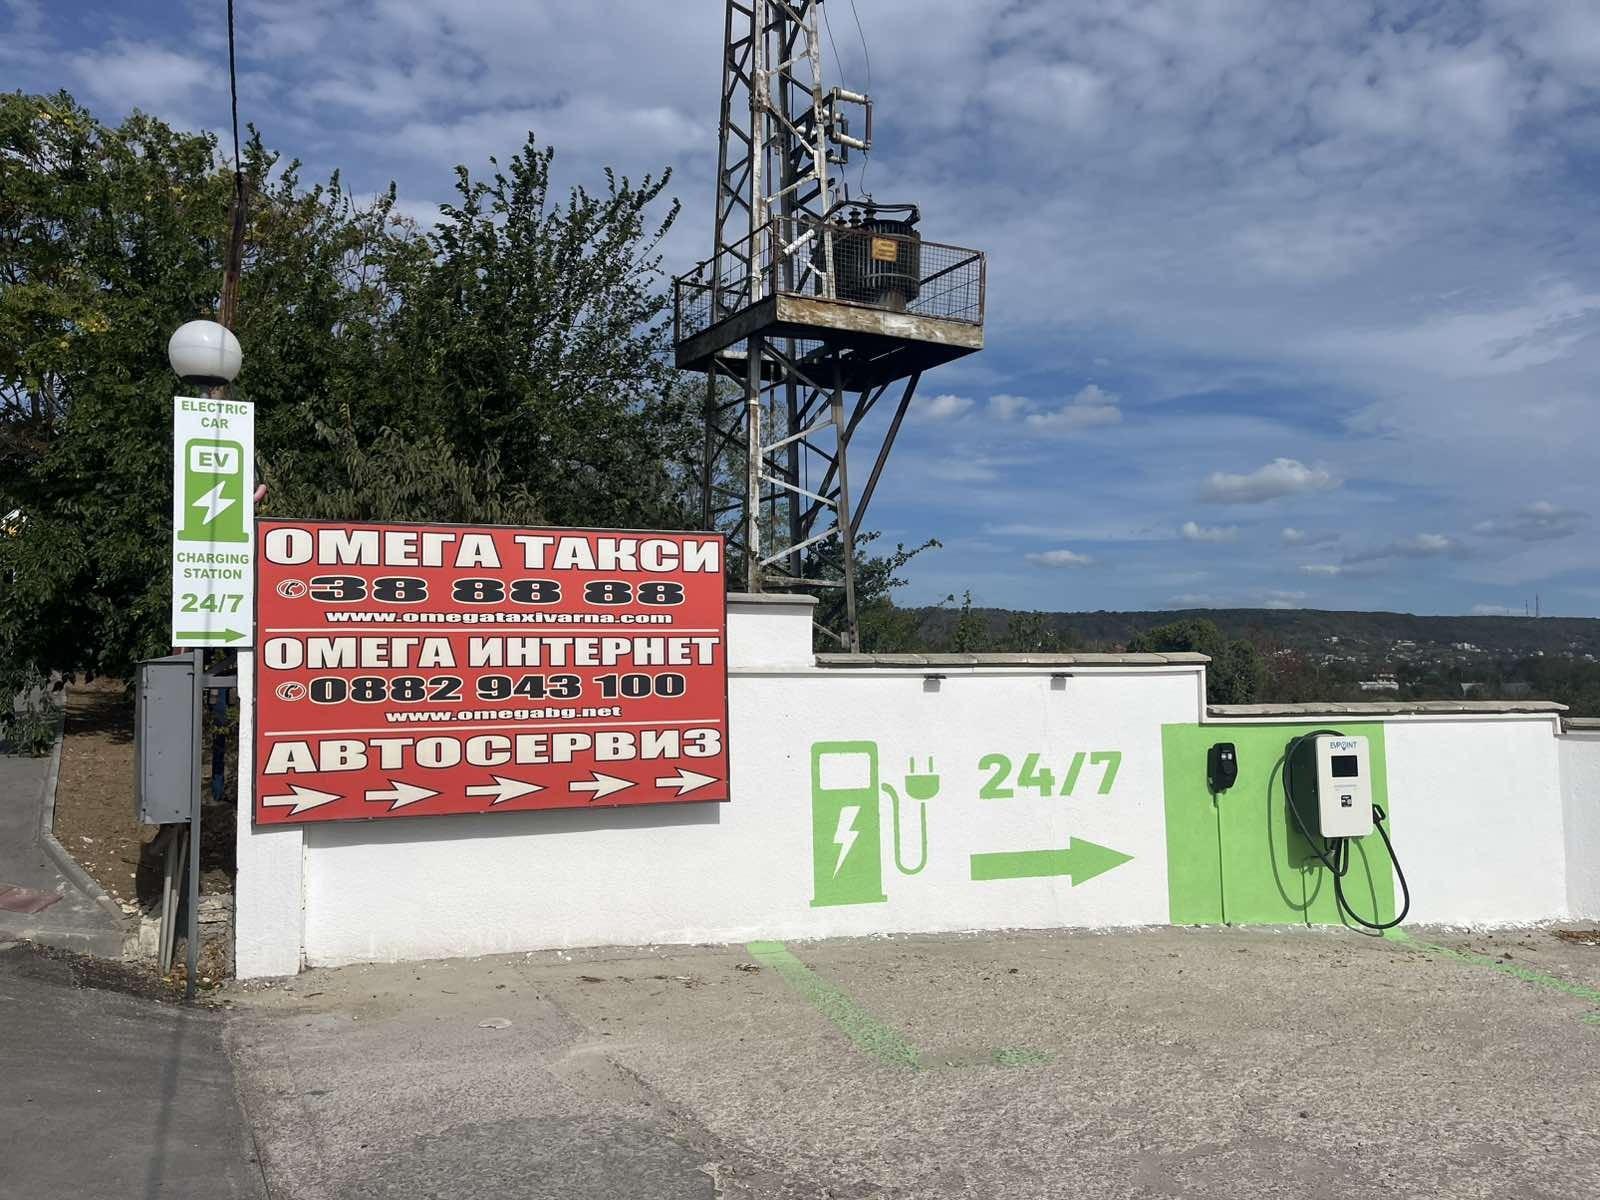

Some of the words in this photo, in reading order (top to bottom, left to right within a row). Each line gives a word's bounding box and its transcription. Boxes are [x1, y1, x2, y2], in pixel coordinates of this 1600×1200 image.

[181, 400, 248, 415] ELECTRIC
[201, 417, 229, 429] CAR
[199, 452, 230, 468] EV
[176, 552, 250, 565] CHARGING
[264, 527, 502, 569] ОМЕГА
[514, 534, 721, 574] ТАКСИ
[183, 567, 242, 580] STATION
[309, 575, 429, 604] 38
[451, 578, 563, 605] 88
[583, 580, 685, 606] 88
[180, 593, 244, 614] 24/7
[325, 611, 673, 625] www.omegataxivarna.com
[264, 636, 456, 670] ОМЕГА
[468, 636, 720, 668] ИНТЕРНЕТ
[308, 675, 464, 704] 0882
[476, 673, 582, 702] 943
[593, 672, 686, 699] 100
[385, 706, 622, 723] www.omegabg.net
[263, 728, 722, 776] АВТОСЕРВИЗ
[977, 751, 1122, 800] 24/7
